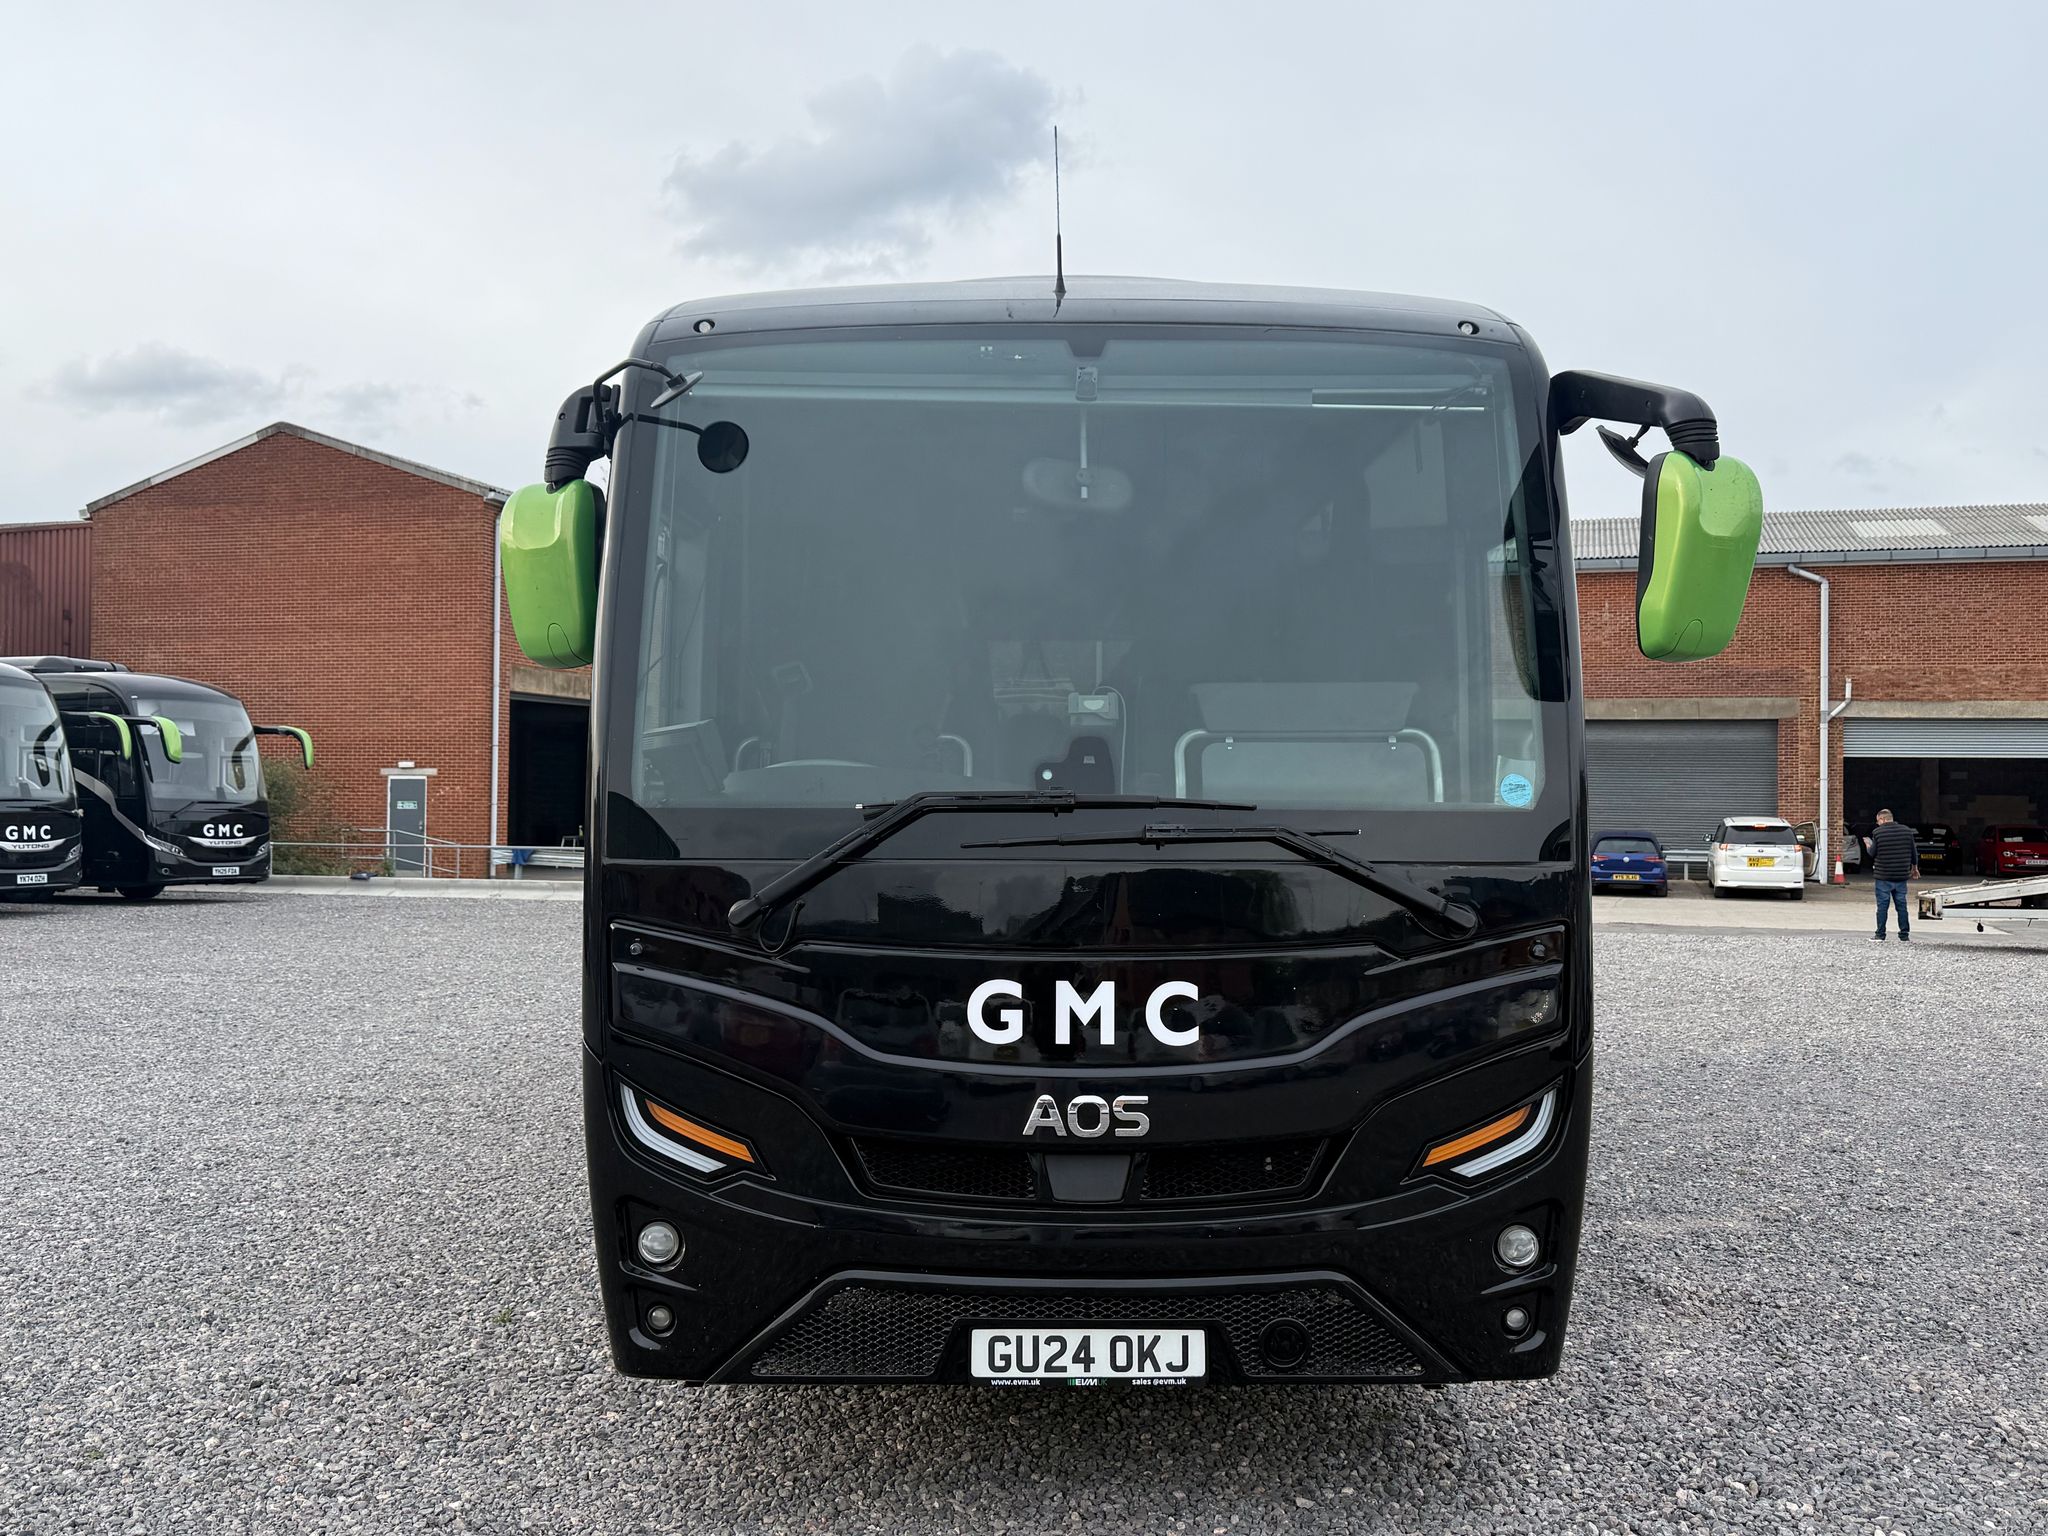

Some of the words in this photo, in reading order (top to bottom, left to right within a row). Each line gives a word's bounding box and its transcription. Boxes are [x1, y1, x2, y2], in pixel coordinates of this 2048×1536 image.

[5, 825, 51, 841] GMC
[203, 823, 244, 838] GMC
[966, 979, 1200, 1047] GMC
[1022, 1094, 1150, 1138] AOS
[987, 1334, 1096, 1374] GU24
[1109, 1334, 1190, 1374] OKJ
[990, 1378, 1041, 1386] www.evm.uk
[1131, 1377, 1152, 1386] sales
